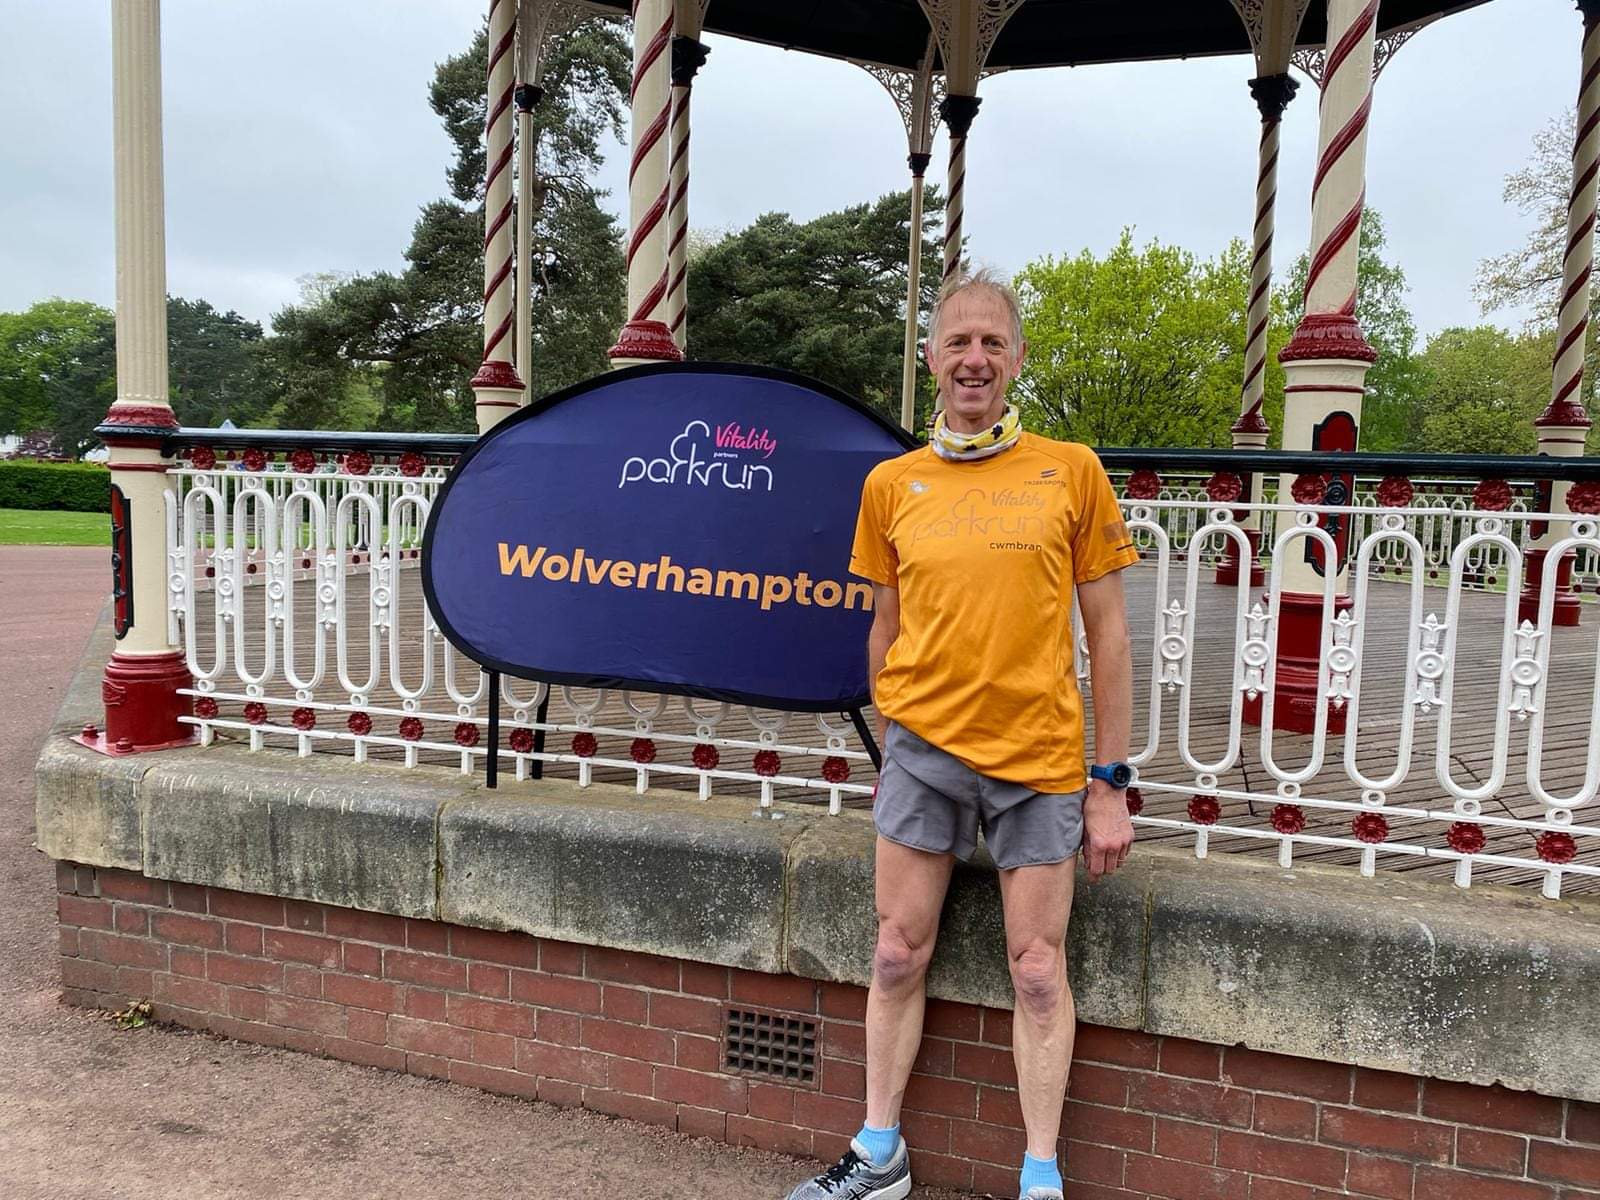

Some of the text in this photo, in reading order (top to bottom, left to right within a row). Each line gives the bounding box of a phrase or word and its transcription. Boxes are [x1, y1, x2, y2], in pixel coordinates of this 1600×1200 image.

[715, 421, 777, 459] Vitality
[618, 439, 773, 491] parkrun
[992, 488, 1046, 512] Vitality
[910, 503, 1044, 547] parkrun
[989, 541, 1042, 551] cwmbran
[497, 542, 874, 611] Wolverhampton
